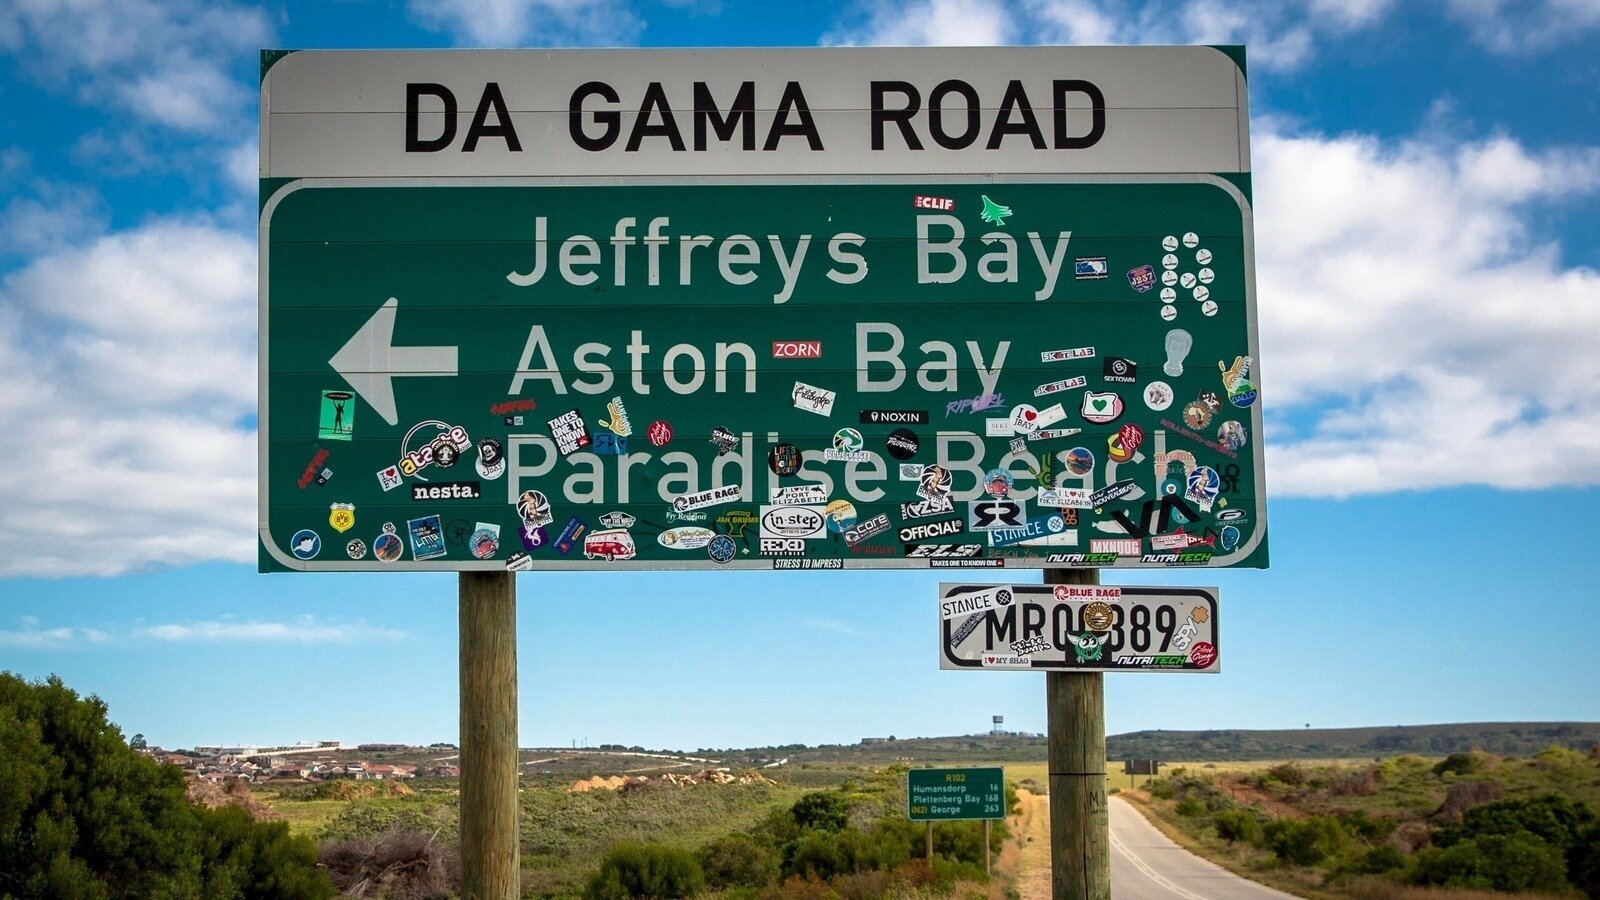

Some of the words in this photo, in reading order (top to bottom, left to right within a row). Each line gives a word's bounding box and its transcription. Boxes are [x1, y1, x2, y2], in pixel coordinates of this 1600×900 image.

[406, 82, 523, 152] DA
[569, 81, 825, 152] GAMA
[871, 79, 1106, 150] ROAD
[922, 197, 953, 210] CLIF
[506, 216, 868, 304] Jeffreys
[917, 214, 1073, 300] Bay
[774, 343, 820, 357] ZORN
[507, 325, 757, 395] Aston
[856, 322, 1011, 410] Bay
[1104, 375, 1136, 383] SEXTOWN
[880, 412, 919, 422] NOXIN
[1017, 407, 1024, 418] I
[547, 410, 578, 430] TAKES
[552, 424, 571, 438] ONE
[569, 416, 584, 429] TO
[1014, 418, 1034, 430] JBAY
[555, 427, 586, 447] KNOW
[712, 429, 740, 443] SURF
[559, 442, 580, 456] ONE
[380, 472, 388, 481] I
[414, 484, 480, 499] nesta.
[688, 492, 712, 506] BLUE
[714, 486, 740, 498] RAGE
[1094, 483, 1137, 508] NOUVEAUBEATS
[773, 496, 826, 505] ELIZABETH
[1057, 498, 1091, 506] ELIZABETH
[857, 514, 888, 533] core
[994, 521, 1043, 542] STANCE
[1092, 541, 1139, 555] MXNDOG
[775, 559, 801, 568] STRESS
[802, 559, 812, 568] TO
[811, 559, 842, 568] IMPRESS
[1069, 588, 1093, 597] BLUE
[1096, 588, 1120, 597] RAGE
[943, 594, 991, 616] STANCE
[1173, 616, 1198, 651] SPY
[946, 774, 966, 782] R102
[913, 785, 966, 793] Humansdorp
[990, 783, 999, 791] 16
[913, 795, 962, 804] Plettenberg
[965, 795, 981, 804] Bay
[985, 794, 999, 802] 168
[911, 806, 928, 814] (N2)
[931, 806, 961, 815] George
[985, 805, 999, 813] 263
